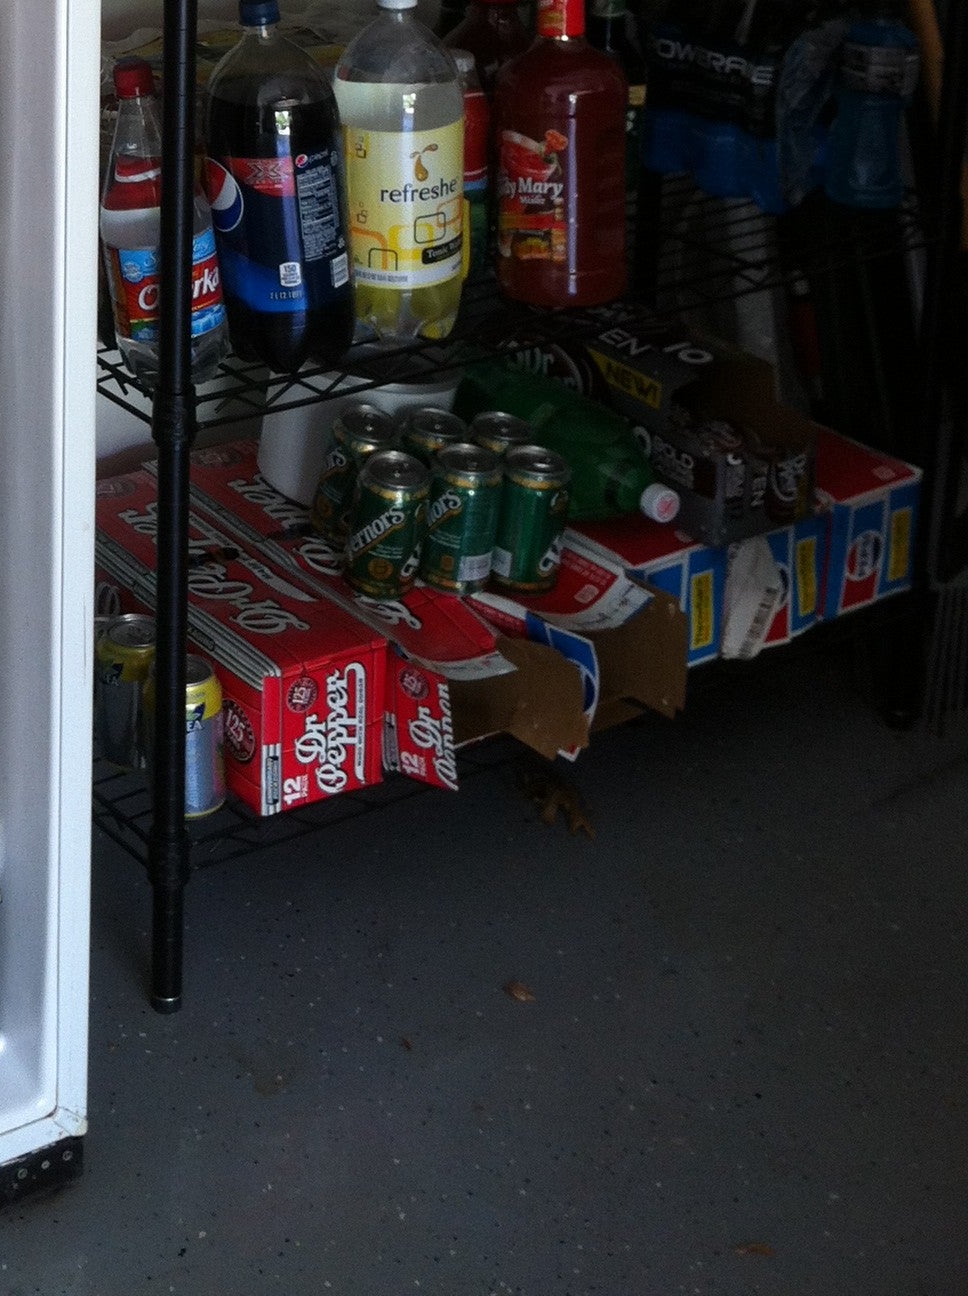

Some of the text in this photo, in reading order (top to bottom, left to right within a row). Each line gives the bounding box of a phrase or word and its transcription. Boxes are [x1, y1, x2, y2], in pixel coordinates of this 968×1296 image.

[518, 174, 564, 201] Mary
[295, 661, 367, 795] Dr Pepper
[408, 705, 446, 757] Dr
[400, 750, 418, 776] 12
[283, 776, 303, 805] 12
